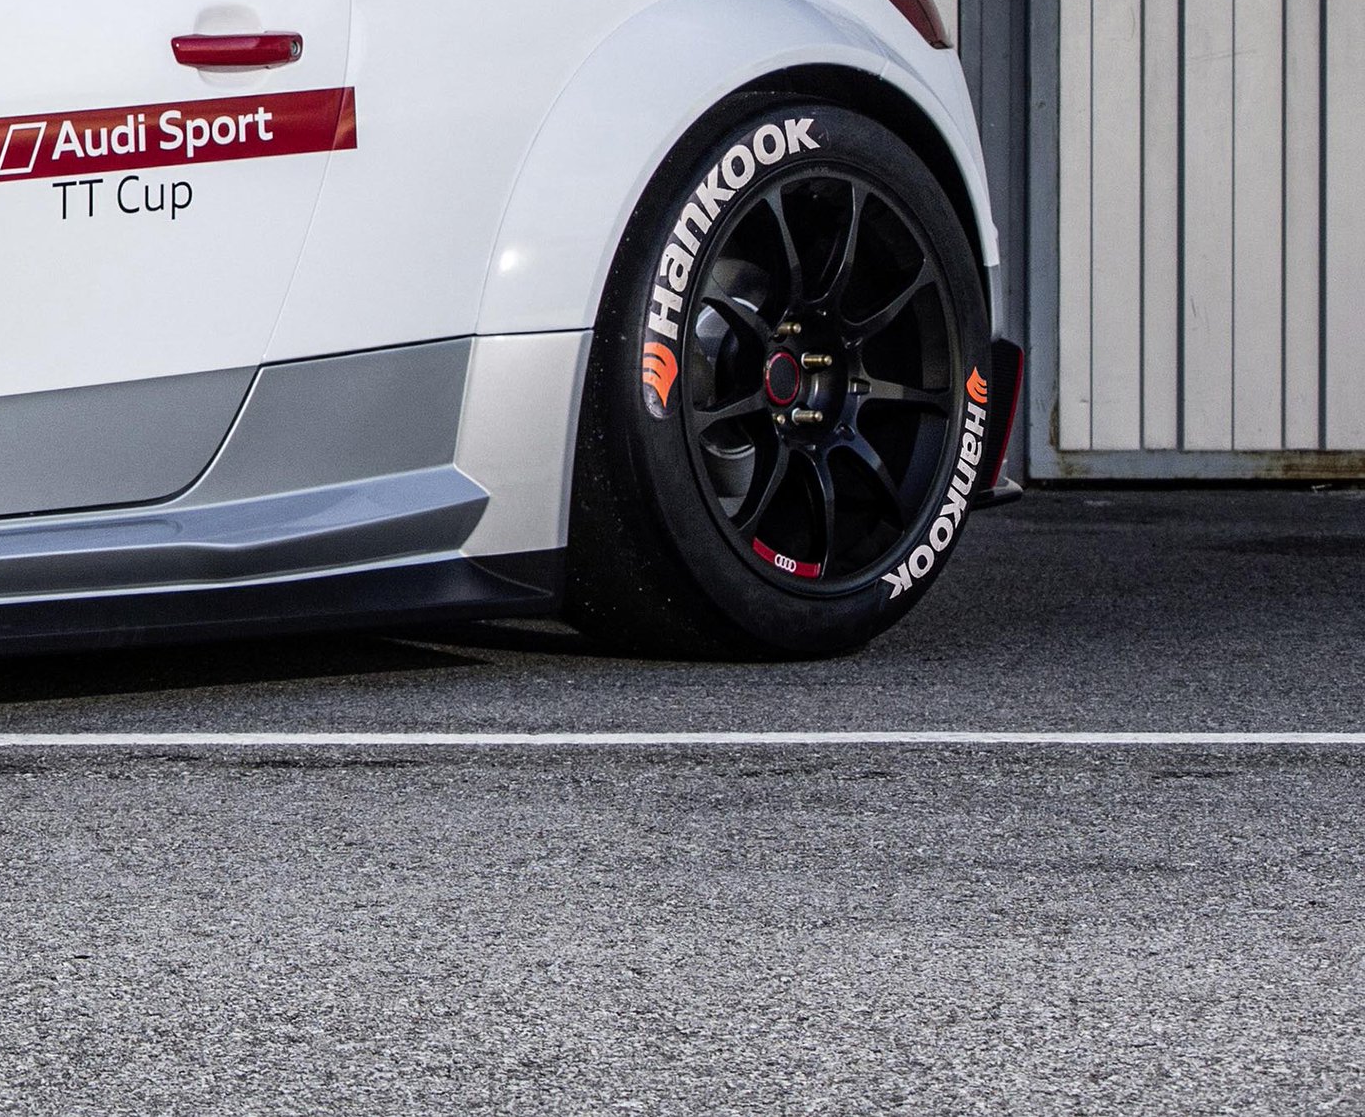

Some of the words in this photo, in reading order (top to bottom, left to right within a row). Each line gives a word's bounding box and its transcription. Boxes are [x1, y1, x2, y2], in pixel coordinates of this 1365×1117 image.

[51, 112, 146, 160] Audi
[158, 106, 274, 158] Sport
[52, 178, 104, 220] TT
[117, 175, 193, 220] Cup
